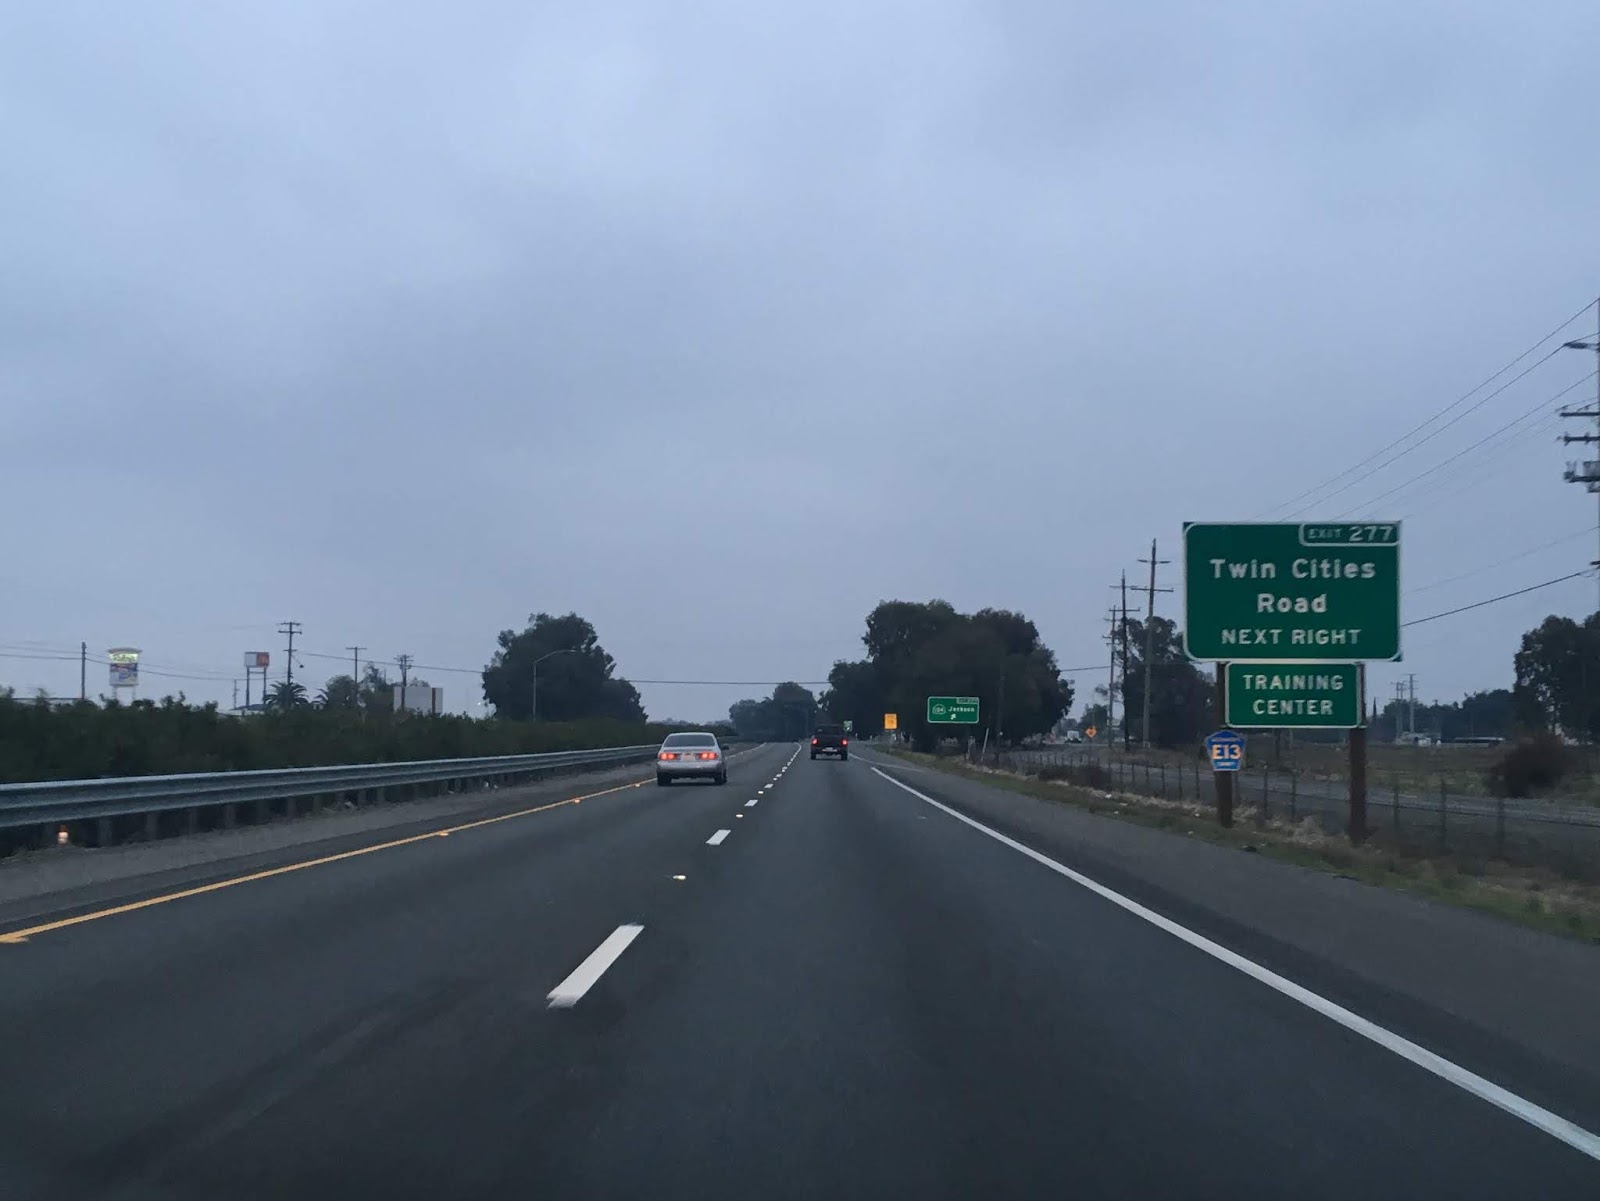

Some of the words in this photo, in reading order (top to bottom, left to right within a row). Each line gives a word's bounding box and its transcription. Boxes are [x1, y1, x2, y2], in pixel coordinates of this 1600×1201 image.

[1308, 528, 1342, 539] EXIT
[1349, 525, 1394, 541] 277
[1209, 558, 1277, 579] Twin
[1291, 558, 1376, 579] Cities
[1256, 593, 1328, 613] Road
[1221, 629, 1282, 645] NEXT
[1291, 629, 1361, 645] RIGHT
[1242, 674, 1344, 690] TRAINING
[1252, 699, 1334, 715] CENTER
[1212, 744, 1241, 760] E13
